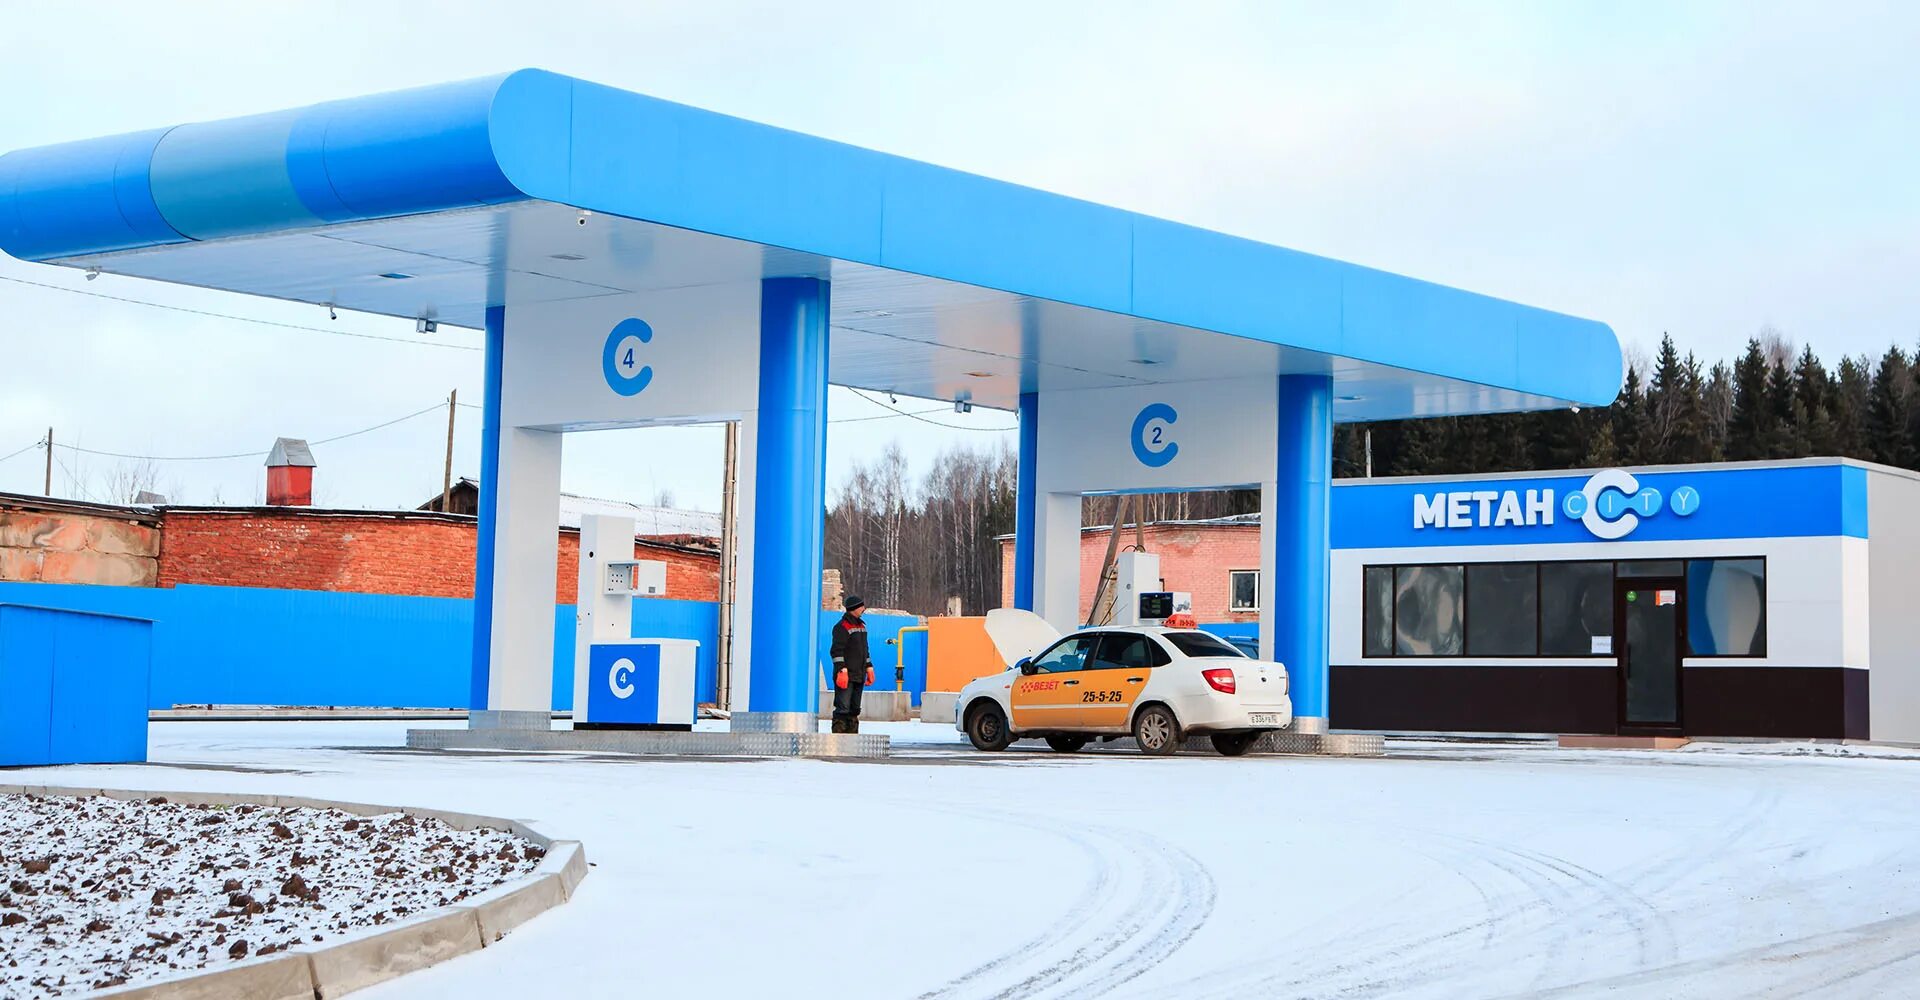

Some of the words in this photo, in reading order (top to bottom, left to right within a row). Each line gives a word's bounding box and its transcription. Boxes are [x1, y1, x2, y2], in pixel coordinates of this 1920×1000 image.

[623, 348, 635, 369] 4
[1152, 427, 1162, 444] 2
[1413, 488, 1555, 529] МЕТАН
[619, 672, 628, 684] 4
[1082, 690, 1123, 703] 25-5-25
